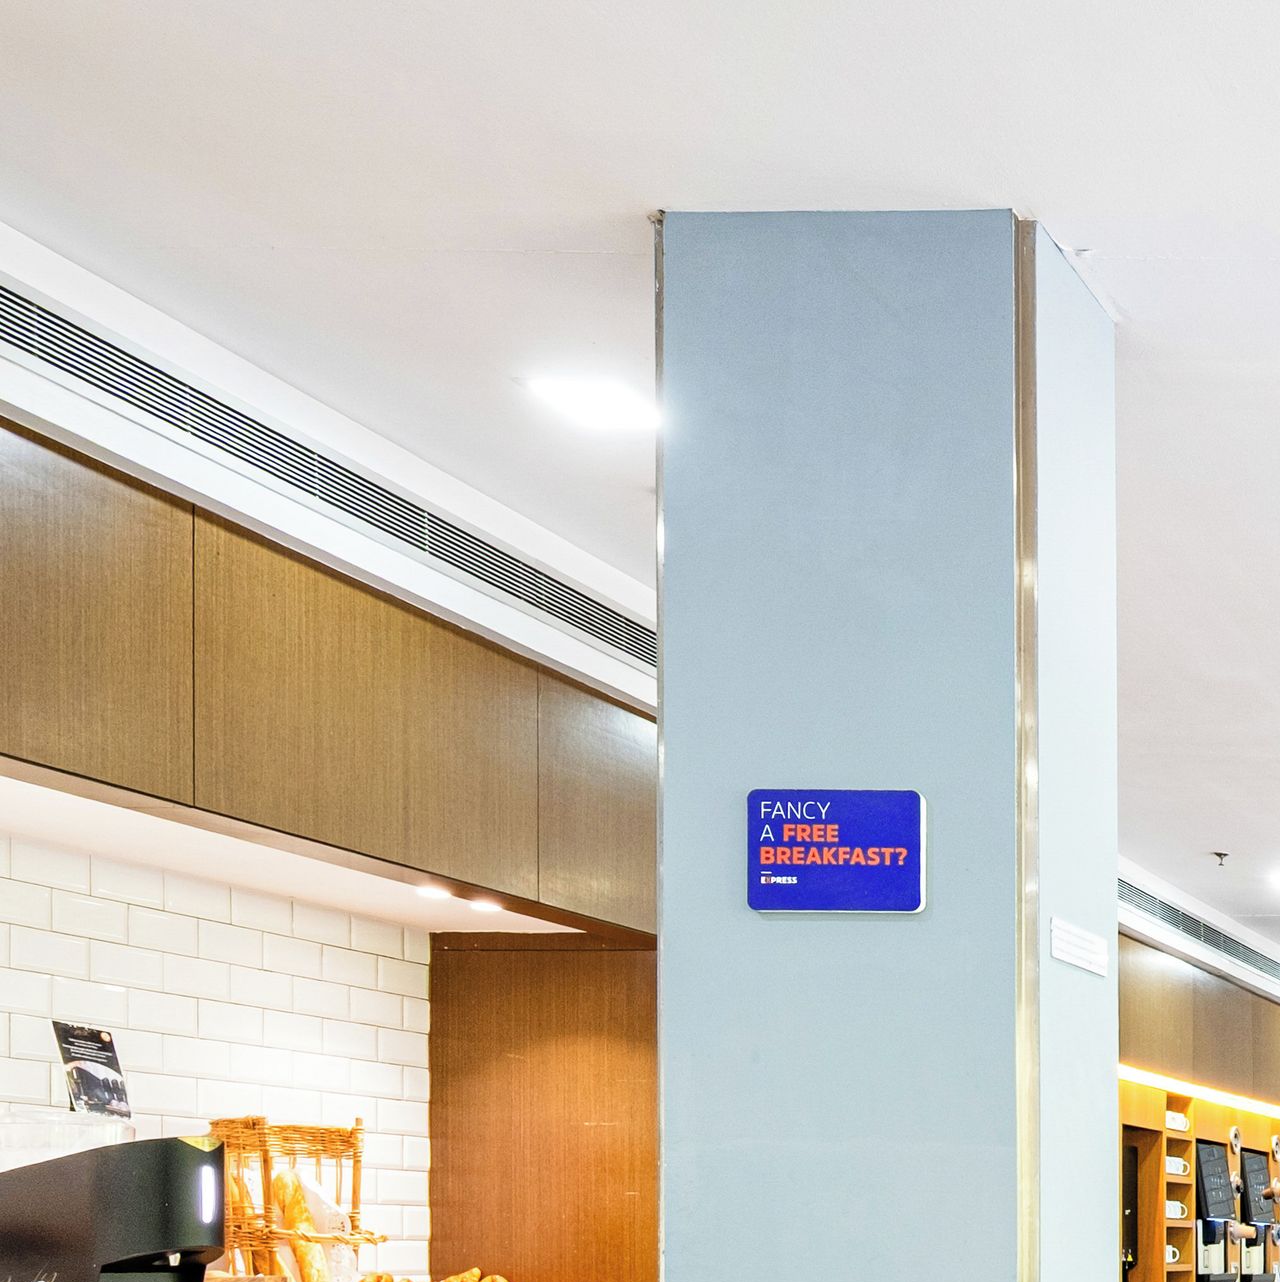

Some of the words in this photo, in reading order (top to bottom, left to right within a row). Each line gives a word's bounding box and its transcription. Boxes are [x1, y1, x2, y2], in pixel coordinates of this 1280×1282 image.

[760, 801, 831, 819] FANCY
[760, 825, 774, 842] A
[783, 824, 839, 842] FREE
[760, 847, 908, 865] BREAKFAST?
